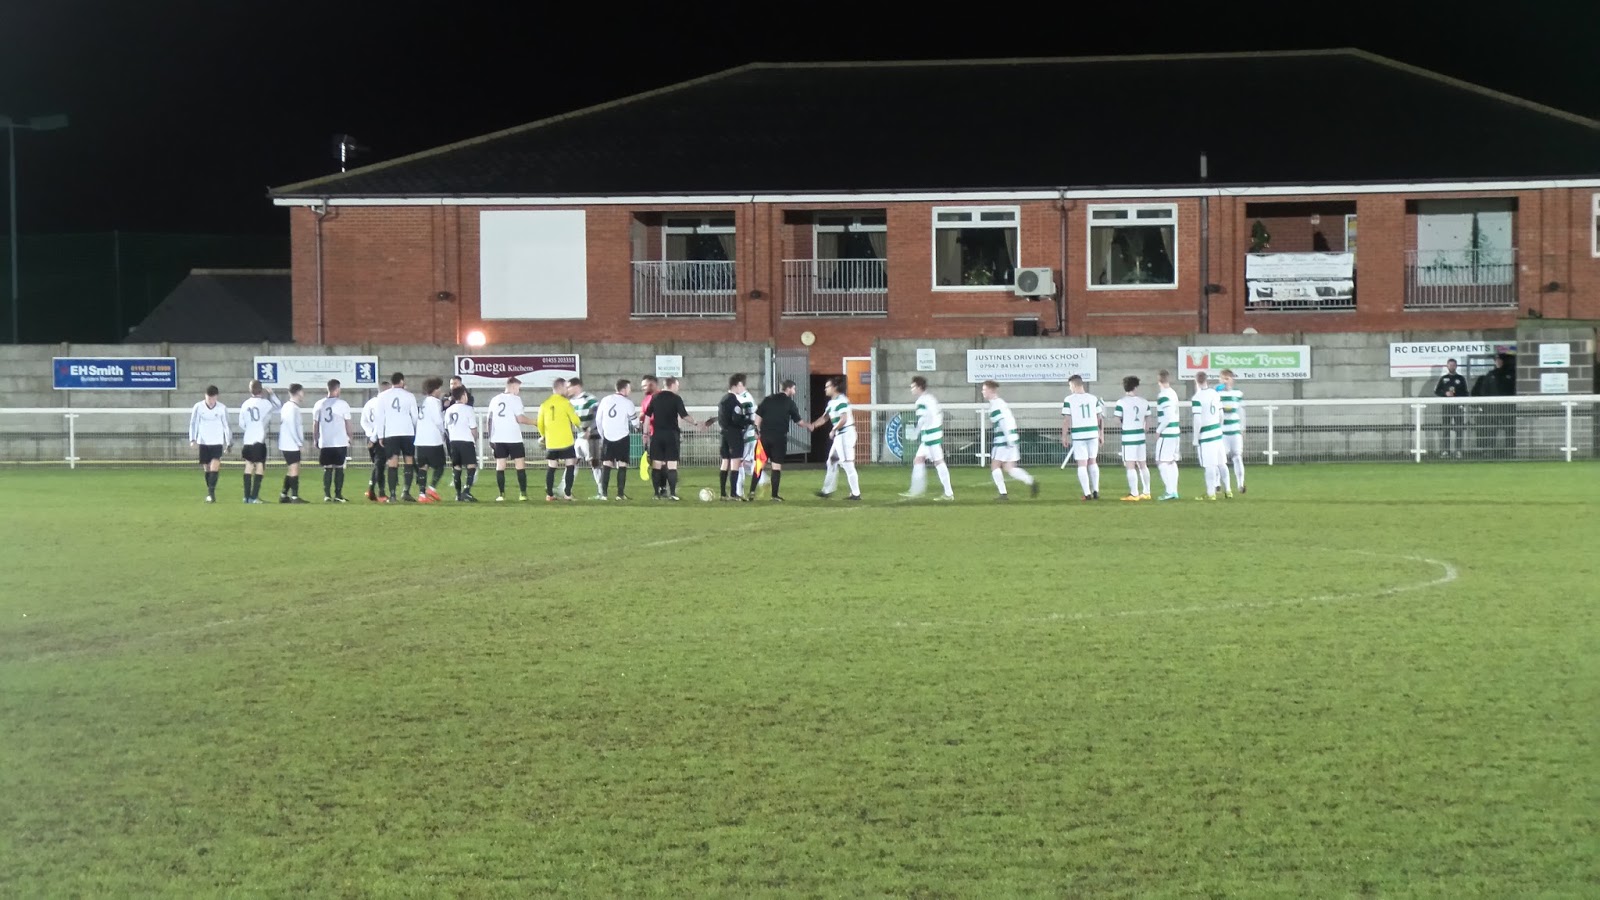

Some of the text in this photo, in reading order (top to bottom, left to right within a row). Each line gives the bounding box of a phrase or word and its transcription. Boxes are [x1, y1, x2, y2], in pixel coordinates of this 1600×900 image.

[1394, 344, 1491, 354] RC DEVELOPMENTS
[1014, 353, 1048, 361] DRIVING
[1214, 353, 1296, 367] Steer Tyres
[507, 364, 534, 372] Kitchens
[391, 397, 401, 413] 4
[498, 402, 506, 417] 2
[608, 403, 617, 418] 6
[1079, 403, 1091, 419] 11
[247, 406, 260, 422] 10
[324, 406, 334, 423] 3
[550, 405, 555, 421] 1
[1133, 405, 1140, 422] 2
